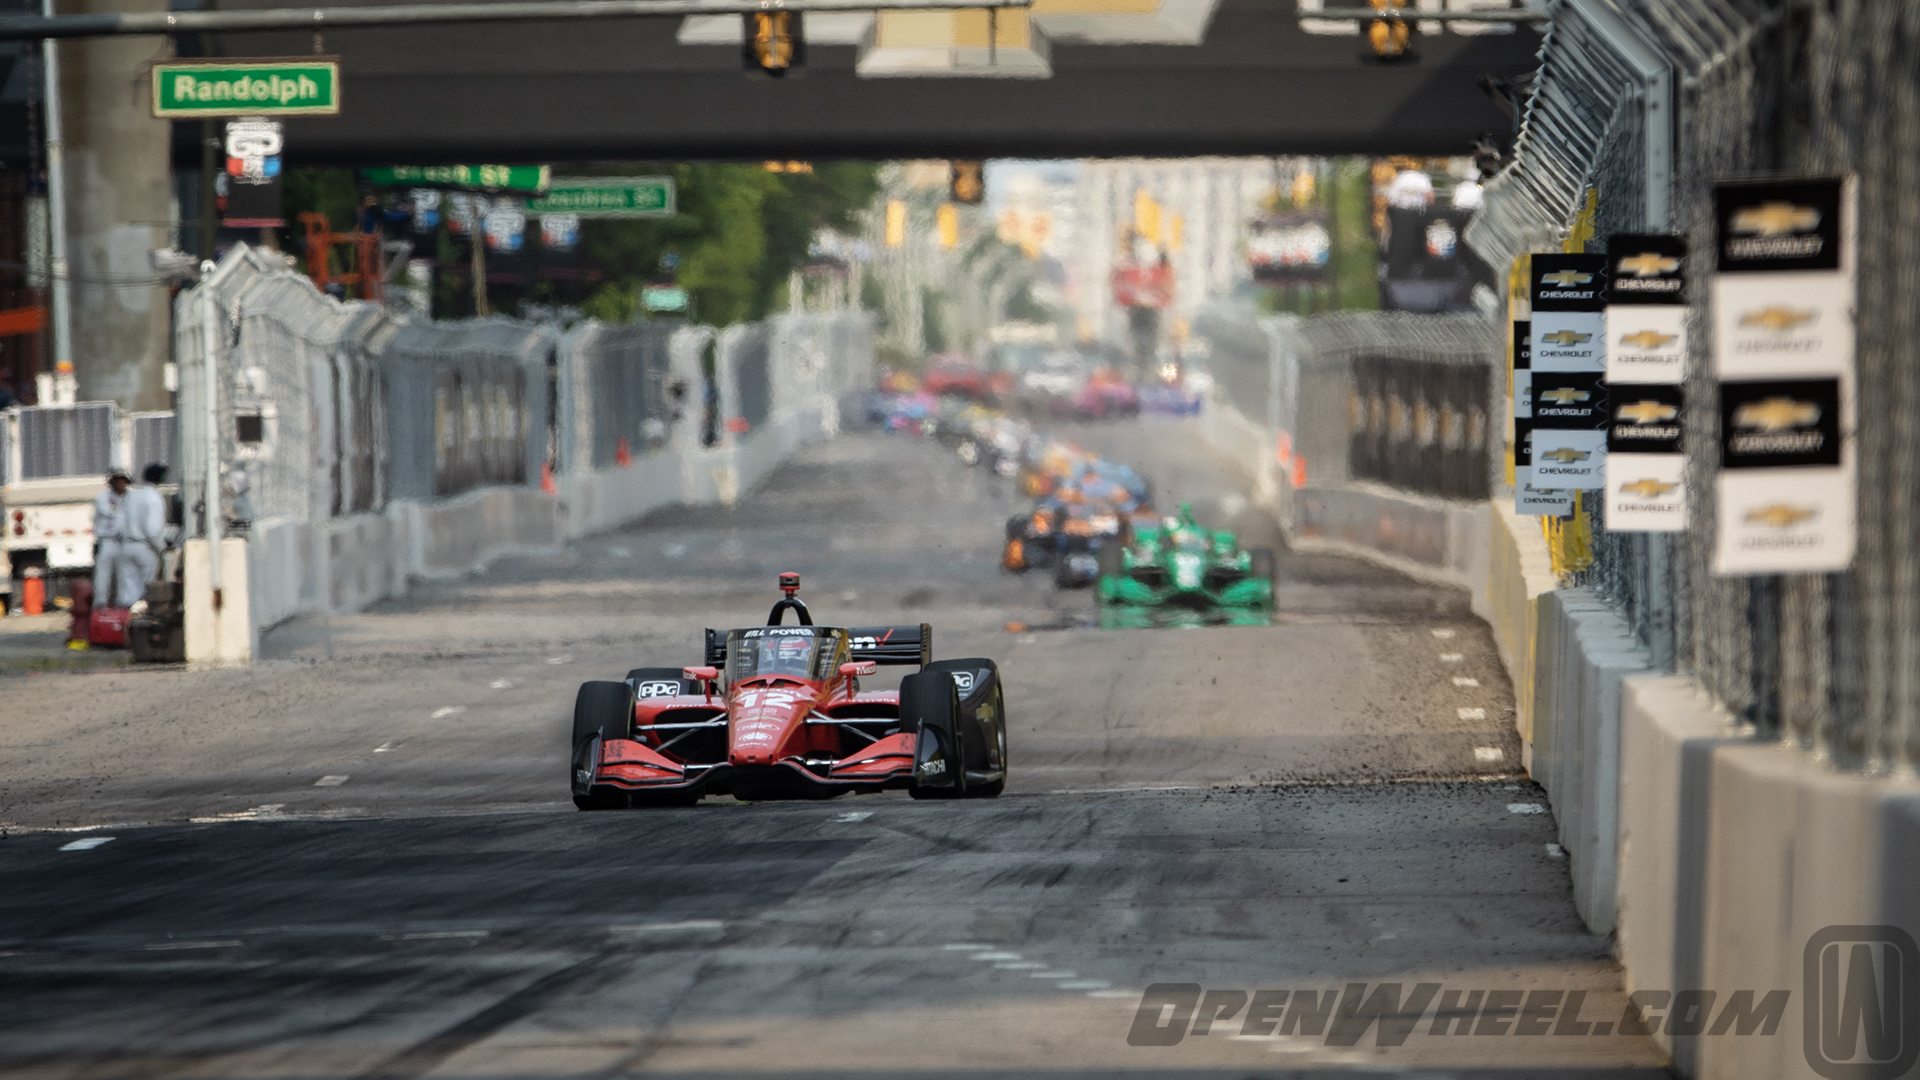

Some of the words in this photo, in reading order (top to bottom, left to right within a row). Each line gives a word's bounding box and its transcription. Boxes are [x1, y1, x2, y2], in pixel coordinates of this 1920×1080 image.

[174, 74, 319, 105] Randolph
[1614, 279, 1682, 291] CHEVROLET
[1539, 290, 1595, 299] CHEVROLET
[1540, 350, 1594, 358] CHEVROLET
[1539, 408, 1593, 416] CHEVROLET
[1539, 467, 1592, 475] CHEVROLET
[769, 628, 815, 637] POWER
[642, 683, 678, 697] PPG
[741, 692, 795, 710] 12
